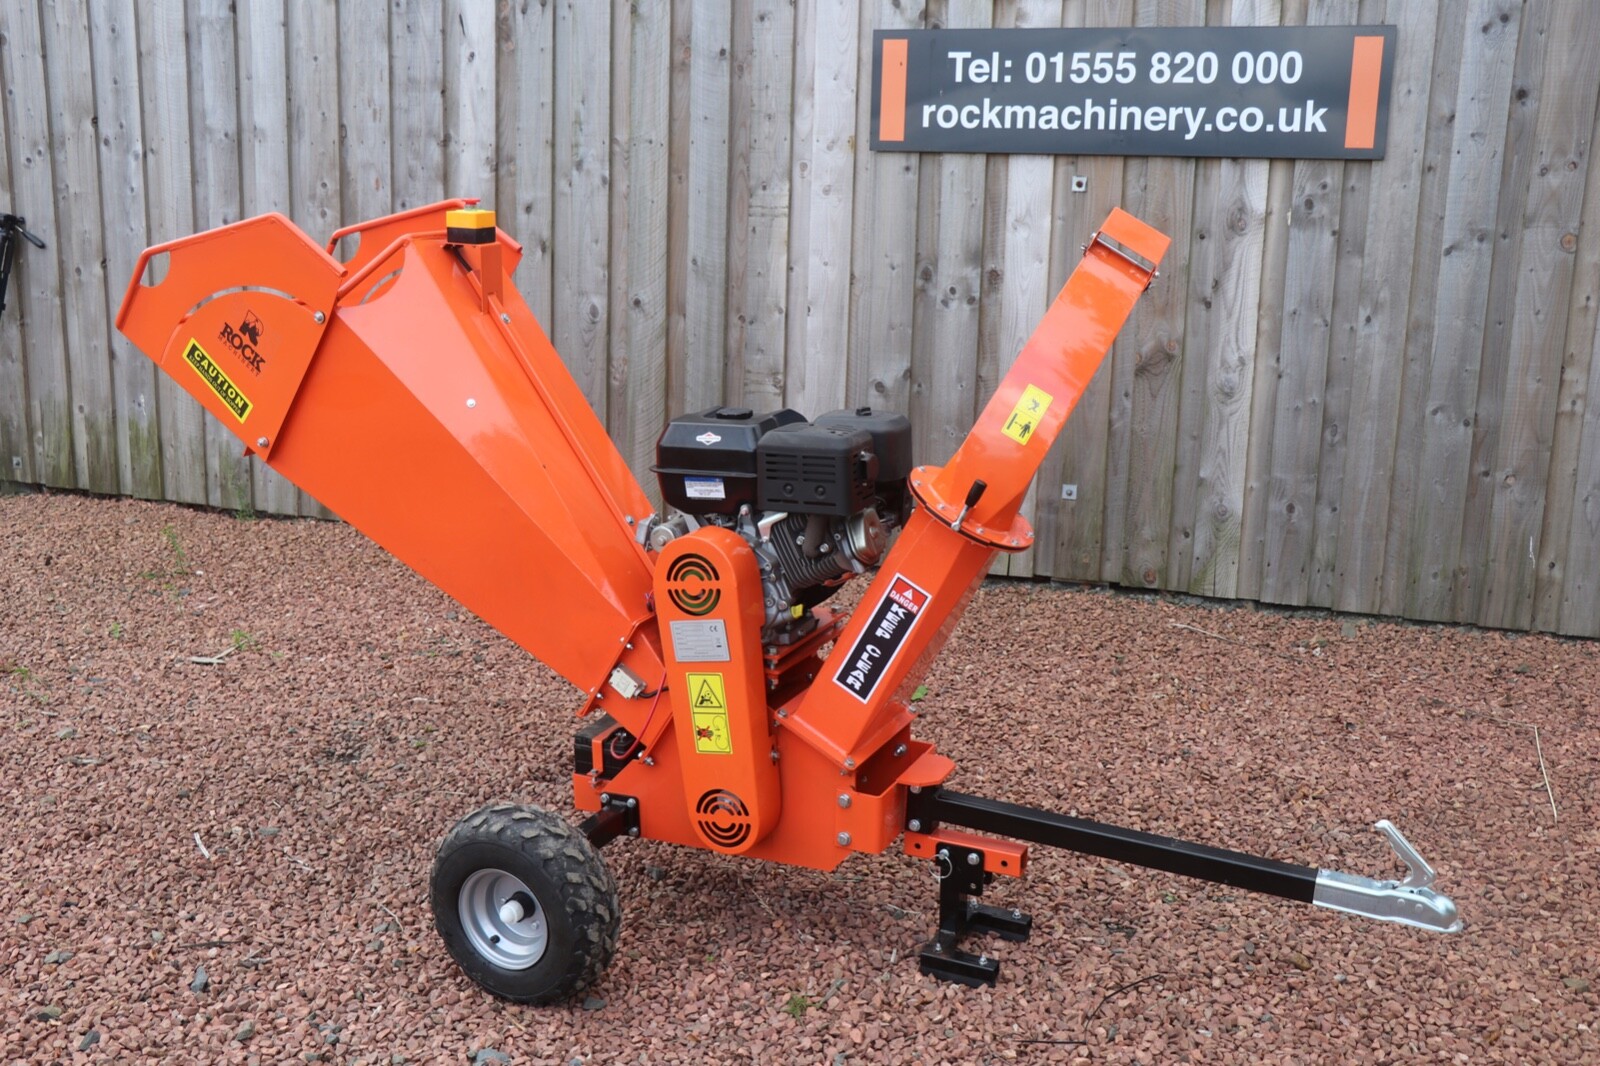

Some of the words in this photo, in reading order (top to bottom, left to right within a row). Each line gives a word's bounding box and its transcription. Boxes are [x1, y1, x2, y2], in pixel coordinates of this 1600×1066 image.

[947, 51, 1013, 83] Tel:
[1025, 51, 1137, 84] 01555
[1148, 51, 1219, 84] 820
[1231, 51, 1303, 84] 000
[921, 98, 1328, 140] rockmachinery.co.uk
[218, 334, 261, 377] MACHINERY
[220, 322, 266, 373] ROCK
[194, 350, 244, 409] CAUTION
[875, 603, 909, 639] KEEP
[889, 590, 919, 614] DANGER
[846, 644, 881, 691] CLEAR
